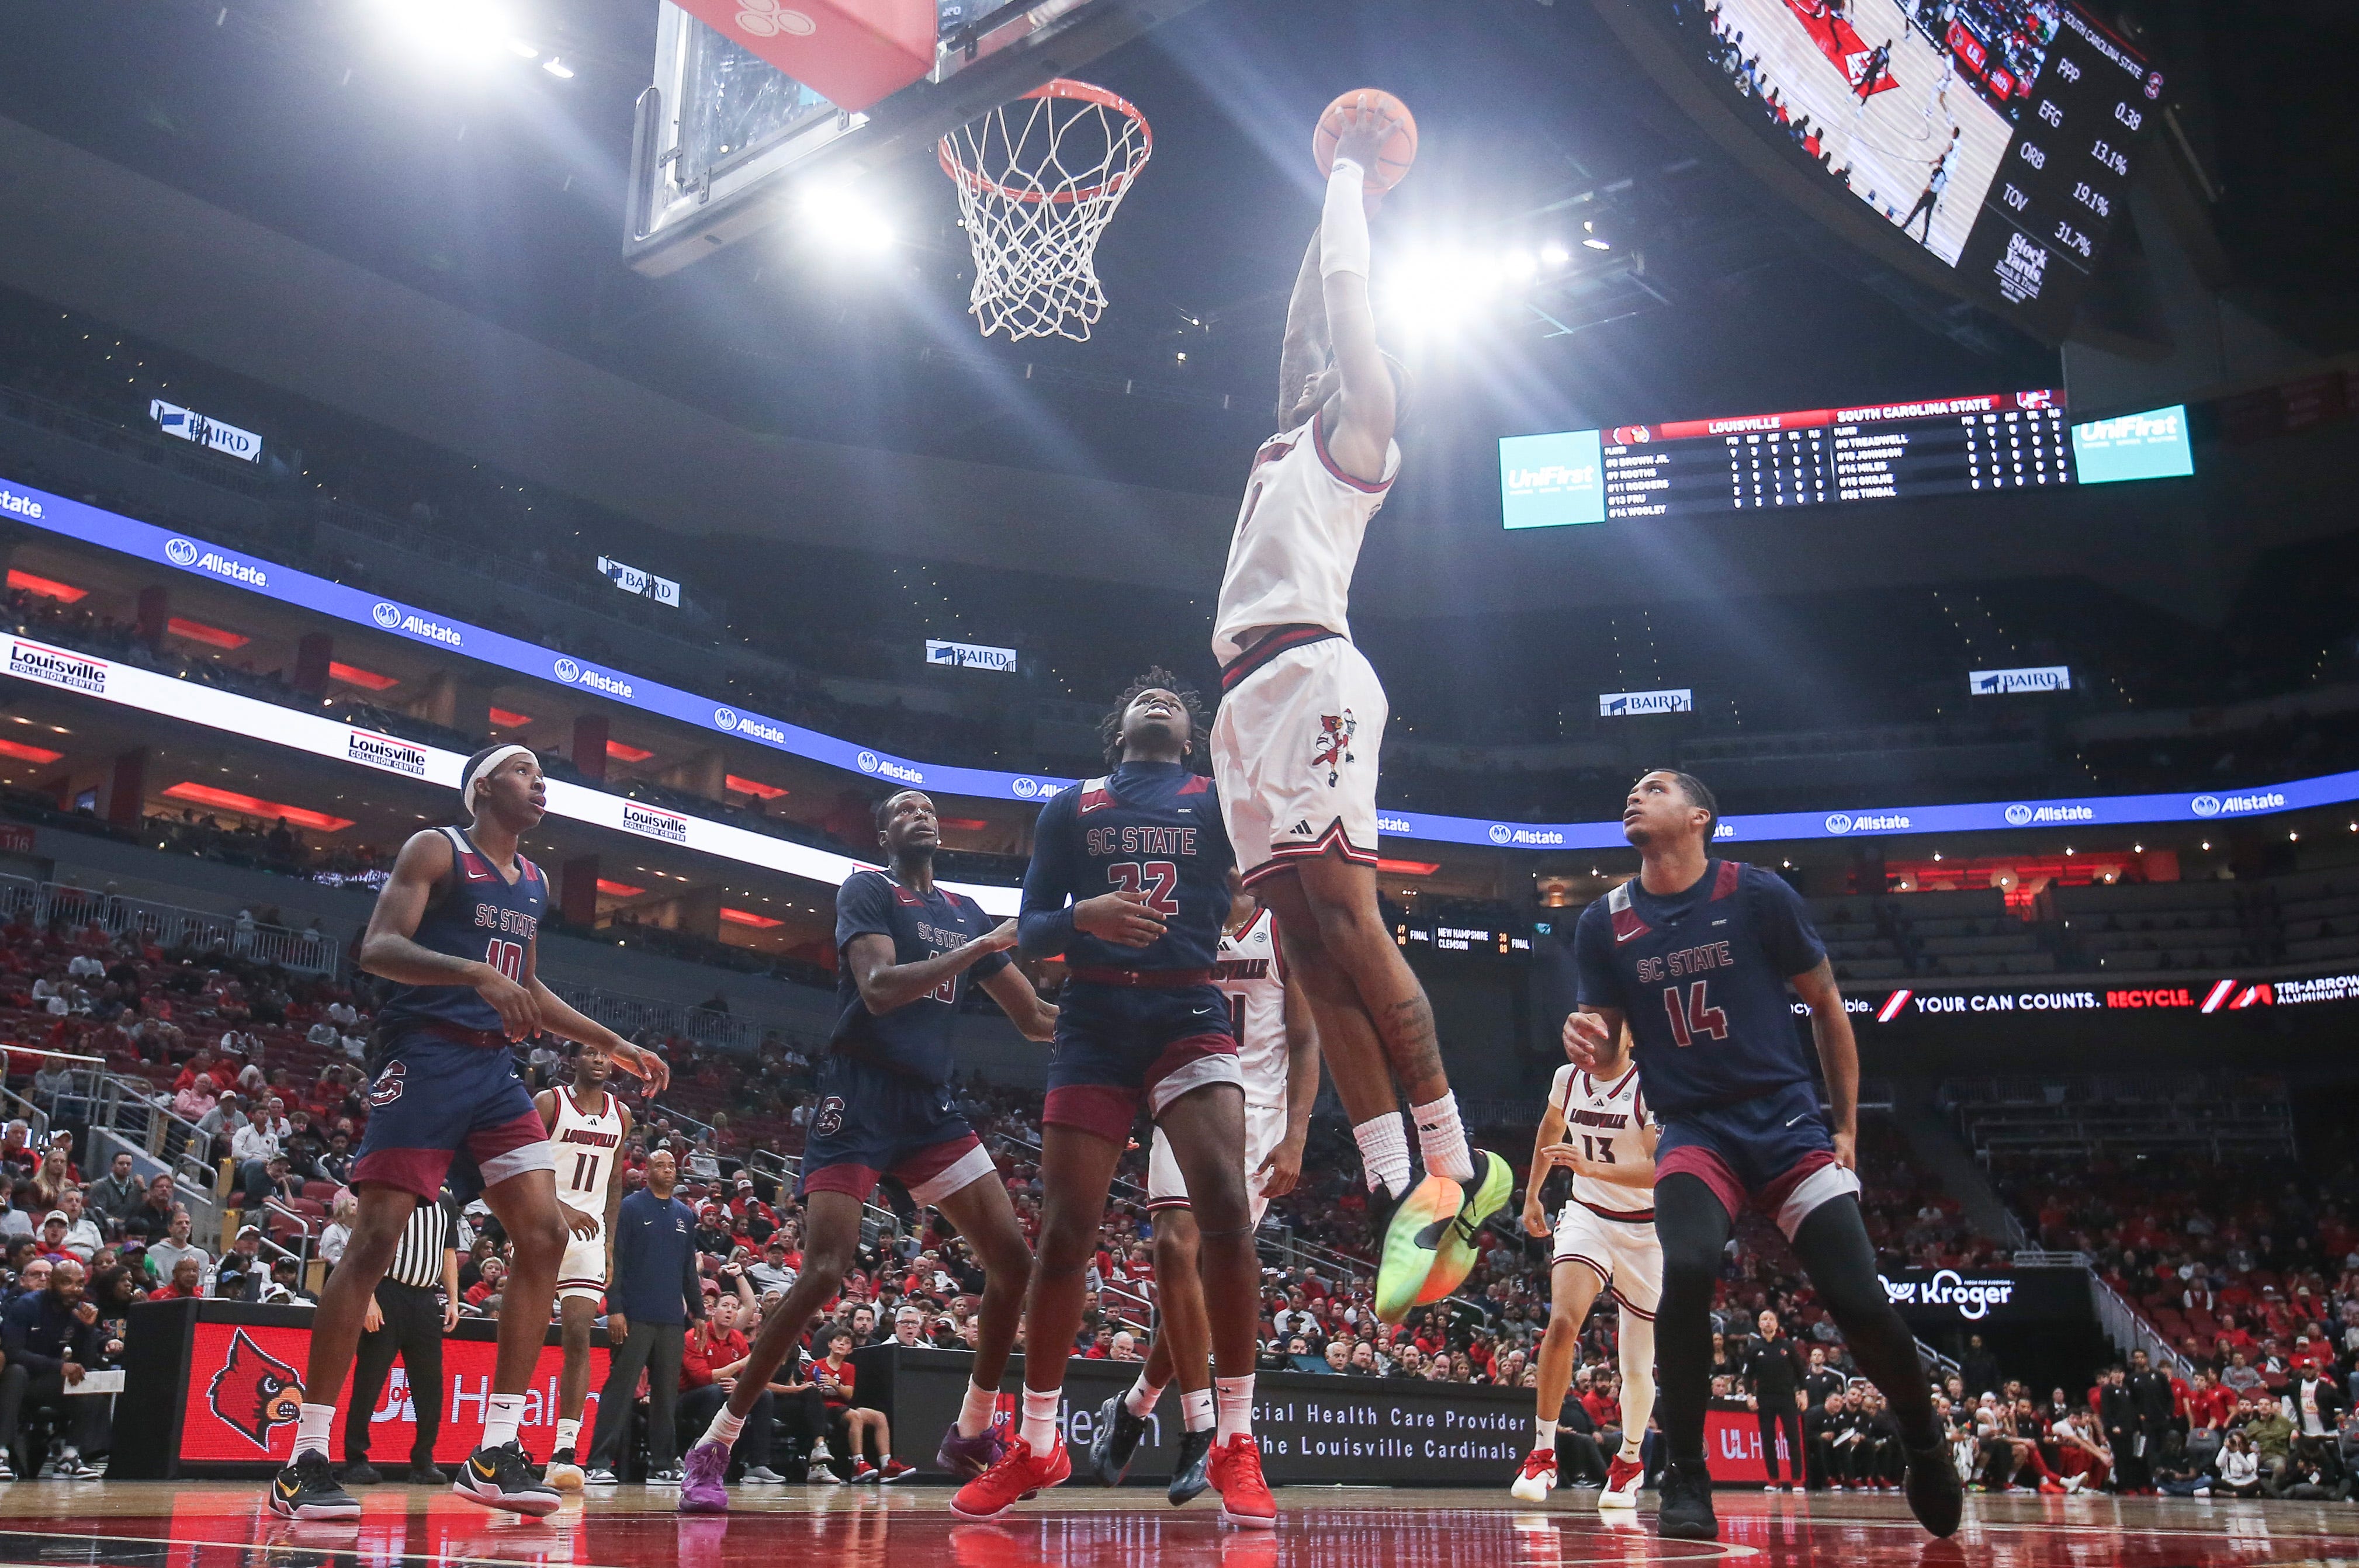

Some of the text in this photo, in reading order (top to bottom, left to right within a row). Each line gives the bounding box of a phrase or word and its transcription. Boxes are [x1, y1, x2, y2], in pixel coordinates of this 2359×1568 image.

[2063, 11, 2143, 79] SOUTH CAROLINA STATE
[2057, 58, 2080, 83] PPP
[2038, 100, 2062, 128] EFG
[2115, 102, 2141, 130] 0.38
[2021, 142, 2045, 169] ORB
[2091, 140, 2127, 175] 13.1%
[2003, 183, 2028, 211] TOV
[2073, 182, 2109, 217] 19.1%
[2055, 221, 2090, 257] 31.7%
[1837, 398, 1991, 422] SOUTH CAROLINA STATE
[1709, 417, 1780, 433] LOUISVILLE
[2081, 415, 2177, 441] UniFirst
[1508, 466, 1594, 488] UniFirst
[11, 646, 106, 682] Louisville
[12, 663, 103, 693] COLLISION CENTER
[2004, 672, 2058, 686] BAIRD
[1631, 695, 1682, 709] BAIRD
[350, 735, 425, 766] Louisville
[351, 750, 422, 775] COLLISION CENTER
[624, 807, 686, 834] Louisville
[625, 821, 684, 841] COLLISION CENTER
[1087, 827, 1197, 856] SC STATE
[475, 903, 536, 940] SC STATE
[917, 921, 968, 949] SC STATE
[1438, 928, 1453, 937] NEW
[1453, 928, 1488, 941] HAMPSHIRE
[1410, 931, 1428, 941] FINAL
[1438, 939, 1468, 950] CLEMSON
[1512, 939, 1529, 949] FINAL
[486, 938, 522, 983] 10
[1637, 941, 1733, 983] SC STATE
[1915, 989, 2194, 1012] YOUR CAN COUNTS. RECYCLE.
[2277, 988, 2344, 1005] ALUMINUM
[1664, 980, 1728, 1047] 14
[1581, 1134, 1616, 1164] 13
[571, 1152, 599, 1192] 11
[1921, 1269, 2012, 1320] Kroger
[1308, 1404, 1377, 1425] Health
[1391, 1408, 1435, 1427] Care
[1446, 1411, 1525, 1431] Provider
[1302, 1437, 1413, 1457] Louisville
[1425, 1440, 1516, 1460] Cardinals
